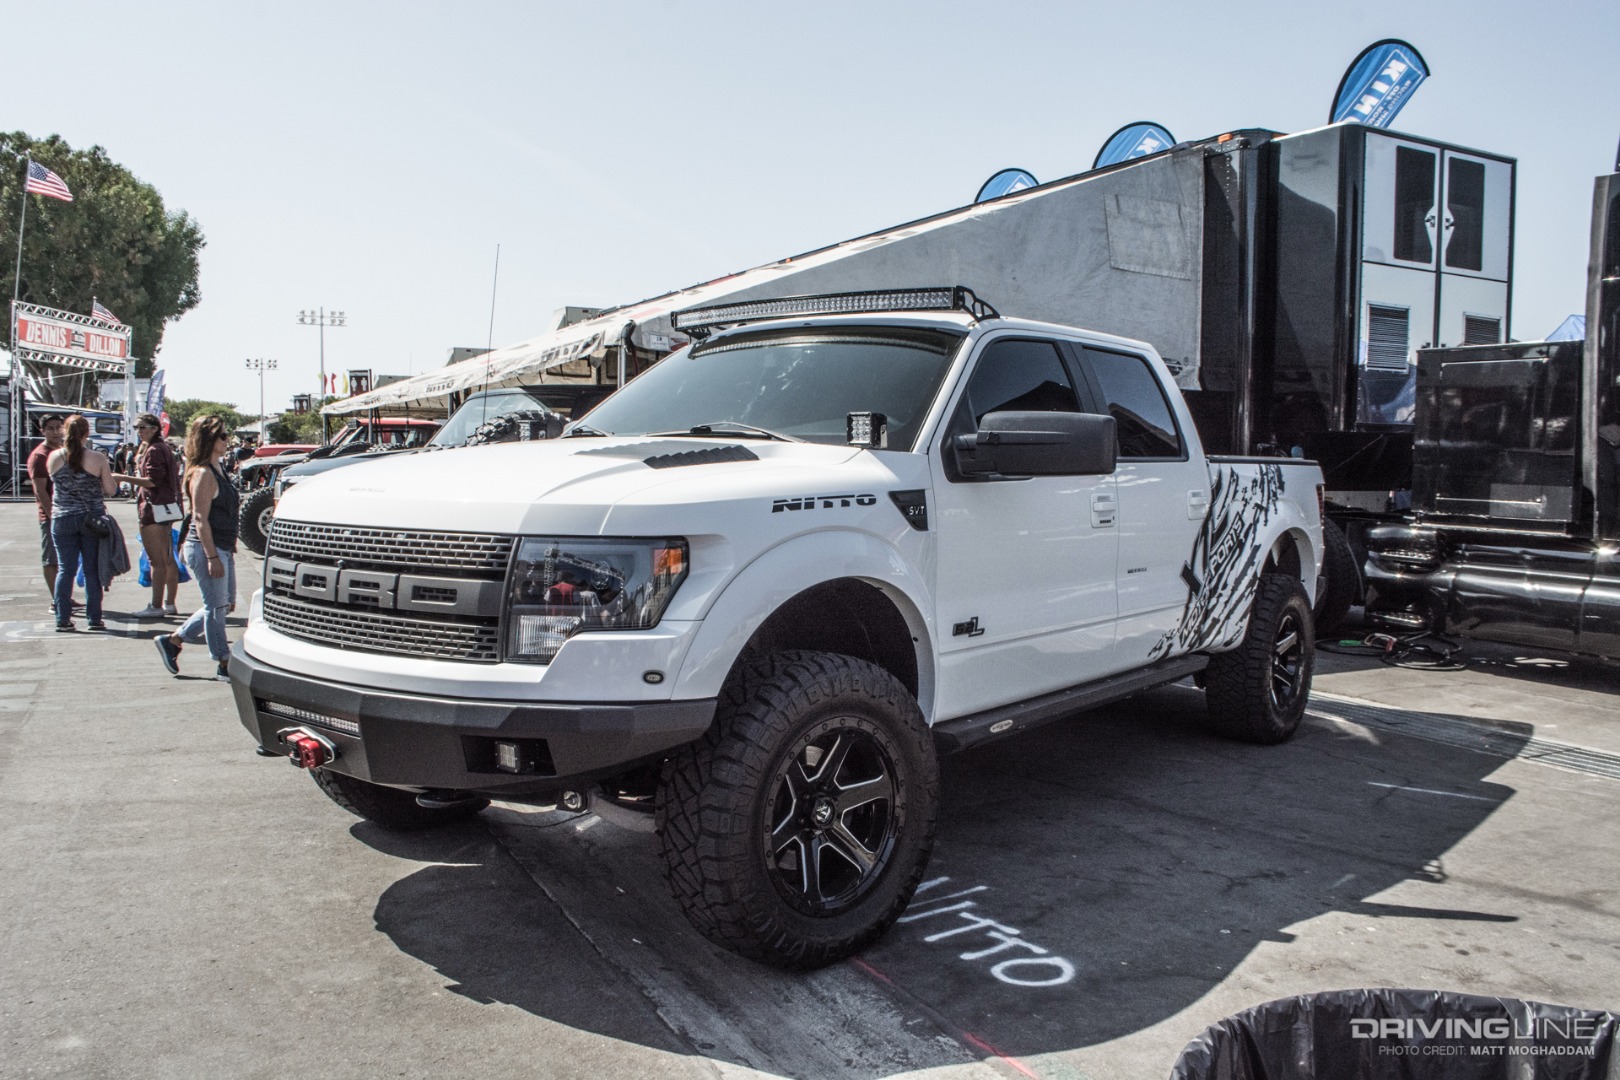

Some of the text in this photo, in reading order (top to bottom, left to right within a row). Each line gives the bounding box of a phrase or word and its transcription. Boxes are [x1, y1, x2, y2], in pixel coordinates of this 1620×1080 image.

[25, 321, 121, 356] DENNIS DILLON
[772, 493, 877, 513] NITTO
[909, 505, 925, 516] SVT
[265, 555, 504, 616] FORD
